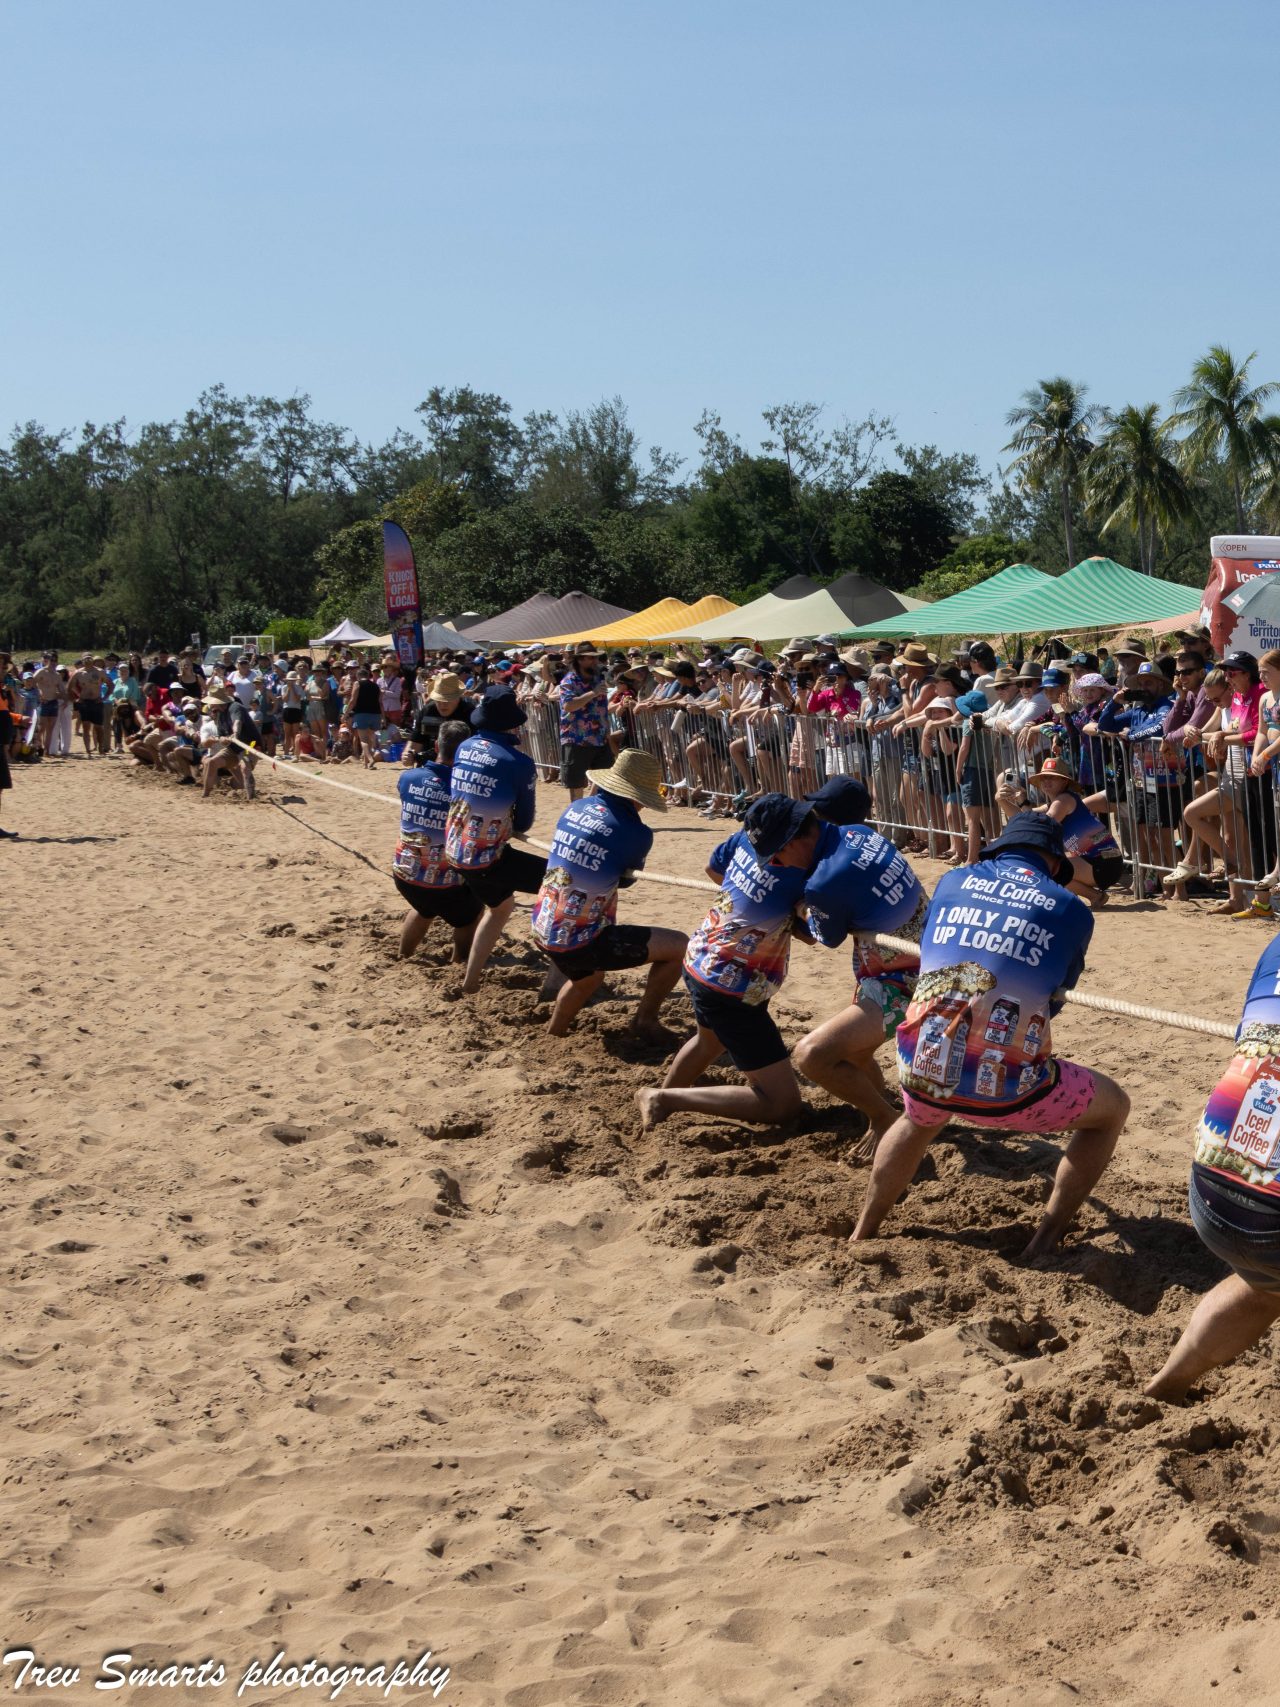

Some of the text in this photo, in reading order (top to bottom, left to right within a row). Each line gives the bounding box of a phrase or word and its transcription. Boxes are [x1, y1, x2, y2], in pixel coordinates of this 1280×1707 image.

[1225, 544, 1247, 552] OPEN
[388, 568, 414, 583] KNOCK
[390, 582, 407, 596] OFF
[389, 594, 416, 608] LOCAL
[1255, 617, 1267, 627] The
[470, 750, 498, 767] Coffee
[408, 783, 425, 796] Iced
[457, 780, 492, 798] LOCALS
[470, 772, 499, 789] PICK
[406, 801, 427, 816] ONLY
[429, 806, 451, 820] PIC
[413, 815, 446, 830] LOCAL
[564, 807, 613, 837] Iced Coffee
[557, 844, 602, 872] LOCALS
[576, 837, 609, 861] PICK
[851, 847, 874, 871] Iced
[747, 859, 781, 893] PICK
[879, 851, 904, 889] ONLY
[1000, 870, 1036, 886] Pauls
[729, 866, 767, 904] LOCALS
[883, 884, 905, 906] UP
[960, 874, 1057, 911] Iced Coffee
[970, 891, 1032, 911] SINCE 1961
[936, 906, 1055, 951] I ONLY PICK
[932, 926, 1043, 968] UP LOCALS
[921, 1041, 941, 1060] Iced
[914, 1054, 943, 1076] Coffee
[1254, 1100, 1273, 1113] Pauls
[1244, 1109, 1272, 1134] Iced
[1233, 1124, 1270, 1155] Coffee
